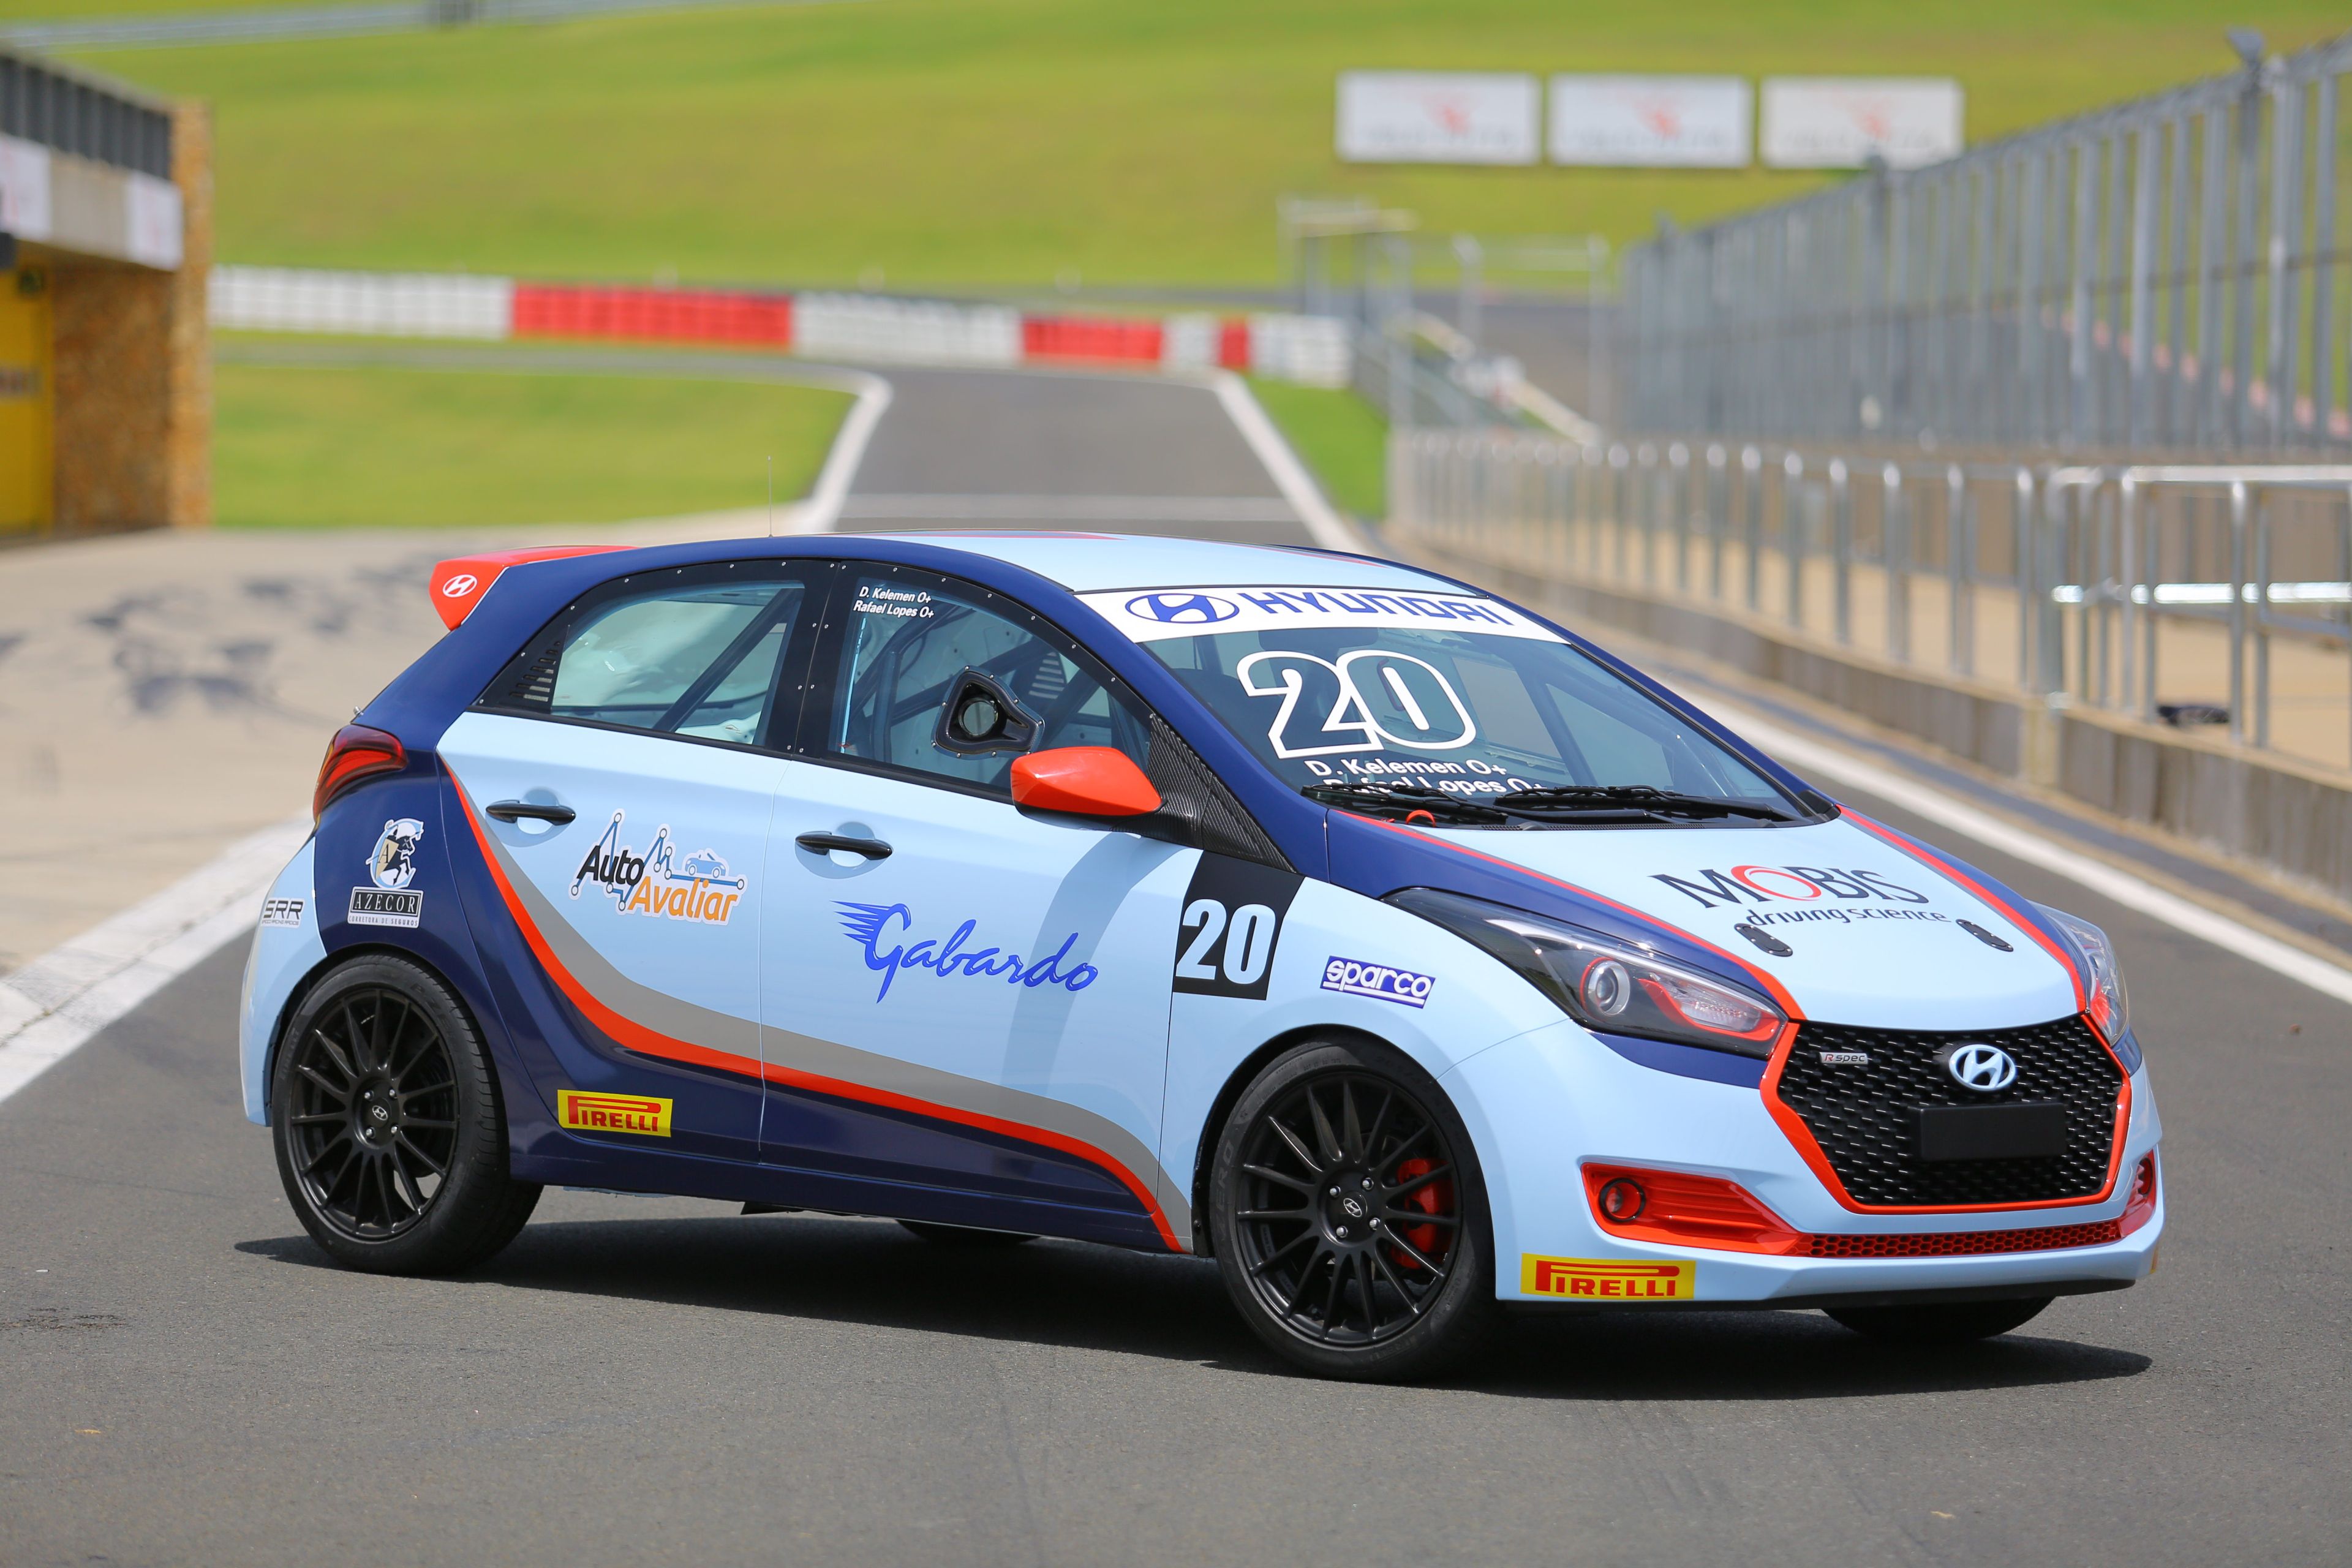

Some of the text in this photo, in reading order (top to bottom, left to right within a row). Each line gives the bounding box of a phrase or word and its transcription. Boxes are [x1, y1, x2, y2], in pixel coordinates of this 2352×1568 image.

[853, 600, 935, 619] Rafael Lopes O+
[859, 586, 932, 603] D. Kelemen O+
[1237, 592, 1515, 626] HYUNDAI
[1236, 649, 1477, 759] 20
[1303, 758, 1507, 776] D. Kelemen O+
[576, 845, 644, 886] Auto
[354, 893, 416, 913] AZECOR
[628, 876, 738, 922] Avaliar
[1646, 865, 1929, 909] MOBIS
[263, 900, 304, 920] SRR
[349, 915, 379, 924] CORRETORA
[391, 918, 418, 926] SEGUROS
[1746, 908, 1952, 925] driving science
[829, 900, 1099, 1004] Gabardo
[1175, 898, 1276, 985] 20
[1325, 958, 1433, 998] sparco
[567, 1095, 662, 1132] PIRELLI
[1535, 1260, 1680, 1296] PIRELLI
